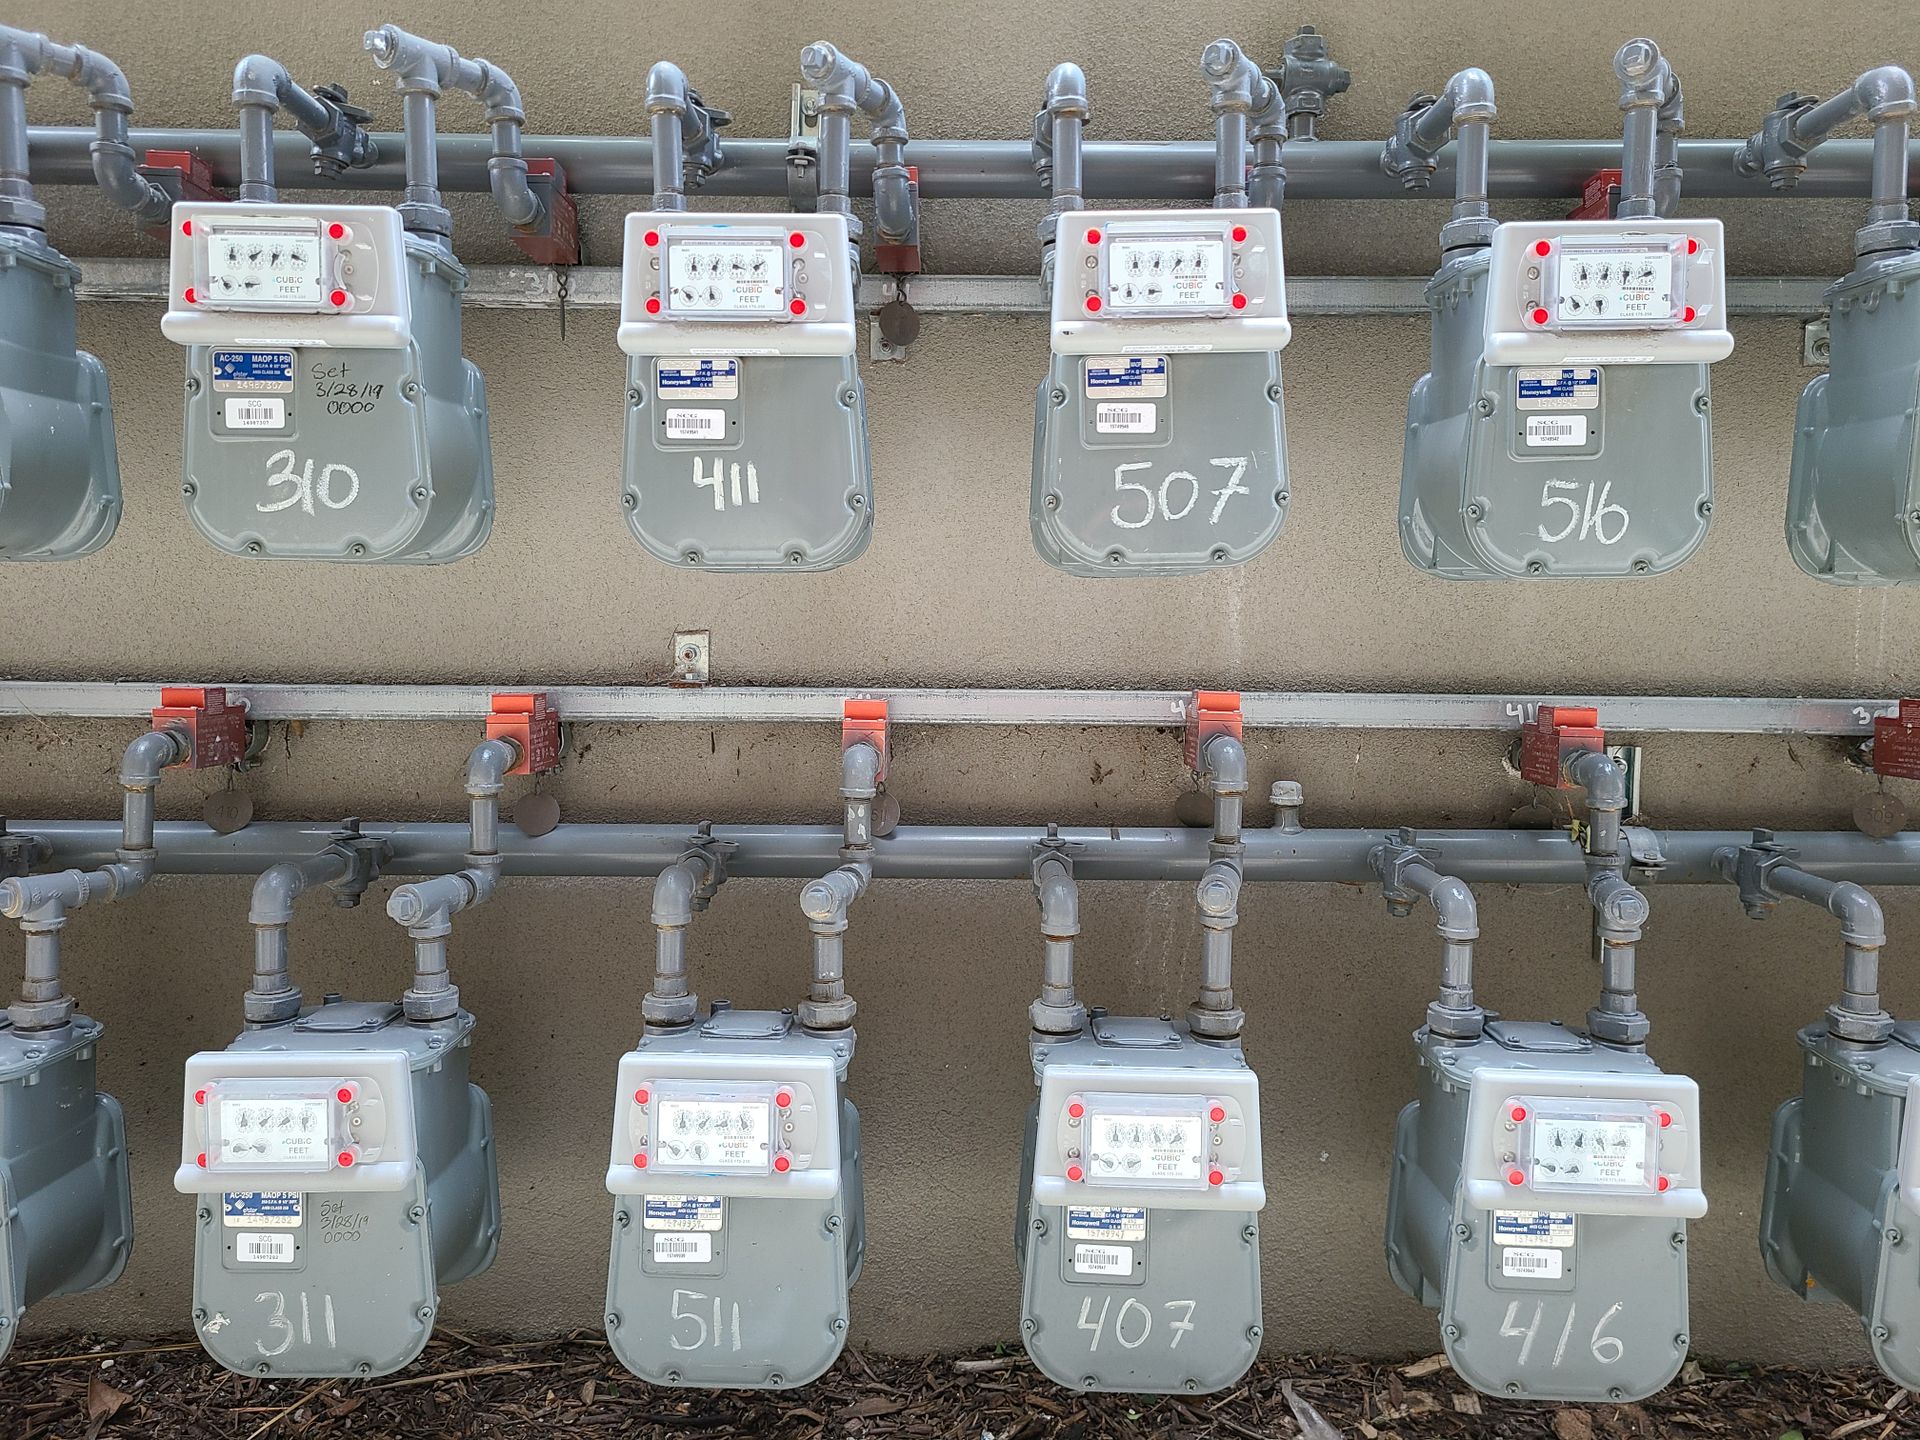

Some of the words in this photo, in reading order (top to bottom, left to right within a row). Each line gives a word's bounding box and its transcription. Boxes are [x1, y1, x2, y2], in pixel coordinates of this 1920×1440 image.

[276, 276, 303, 284] CUBIC
[219, 354, 244, 362] AC-250
[279, 355, 291, 363] PSI
[311, 362, 351, 379] Set
[248, 400, 262, 408] SCG
[326, 401, 374, 415] 0000
[256, 449, 360, 517] 310
[693, 456, 760, 511] 411
[1110, 456, 1250, 529] 507
[1538, 478, 1630, 545] 516
[285, 1137, 312, 1145] CUBIC
[725, 1150, 745, 1158] FEET
[1154, 1154, 1181, 1162] CUBIC
[320, 1200, 345, 1217] Set
[320, 1213, 369, 1230] 3/28/19
[1498, 1225, 1528, 1233] Honeywell
[324, 1230, 361, 1244] 0000
[254, 1290, 337, 1357] 311
[670, 1288, 741, 1352] 511
[1077, 1295, 1196, 1351] 407
[1499, 1299, 1624, 1370] 416
